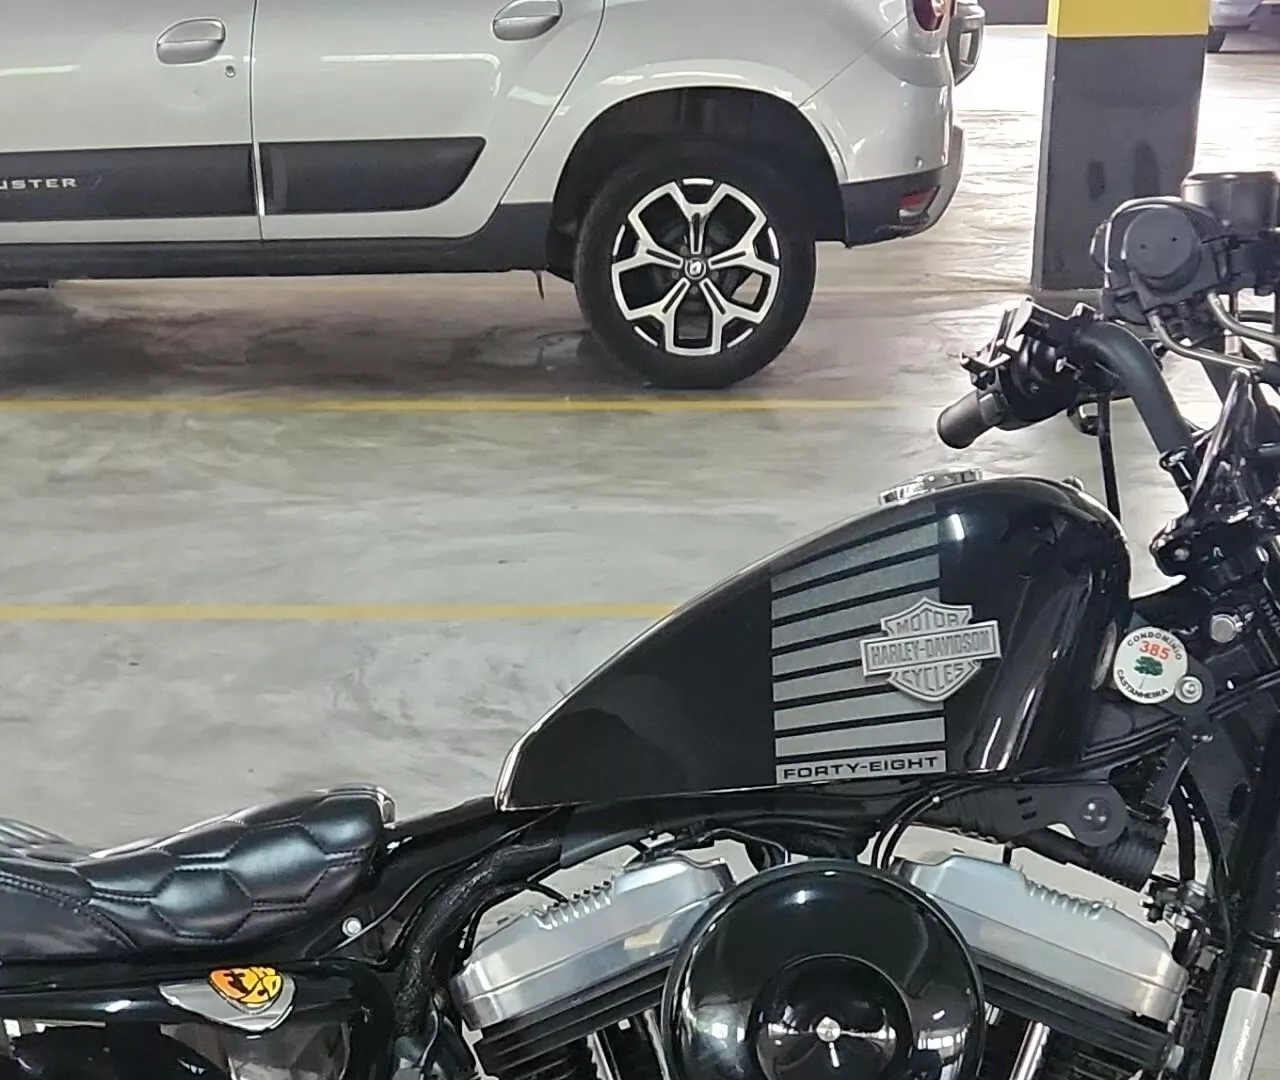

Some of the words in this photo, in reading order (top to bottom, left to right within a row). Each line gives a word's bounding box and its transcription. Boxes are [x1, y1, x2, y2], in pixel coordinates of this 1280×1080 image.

[896, 607, 960, 635] MOTOR
[870, 629, 991, 666] HARLEY-DAVIDSON
[1126, 631, 1183, 661] CONDOMÍNIO
[1139, 640, 1171, 660] 385
[901, 661, 965, 692] CYCLES
[1116, 669, 1169, 699] CASTANHEIRA
[782, 756, 939, 780] FORTY-EIGHT
